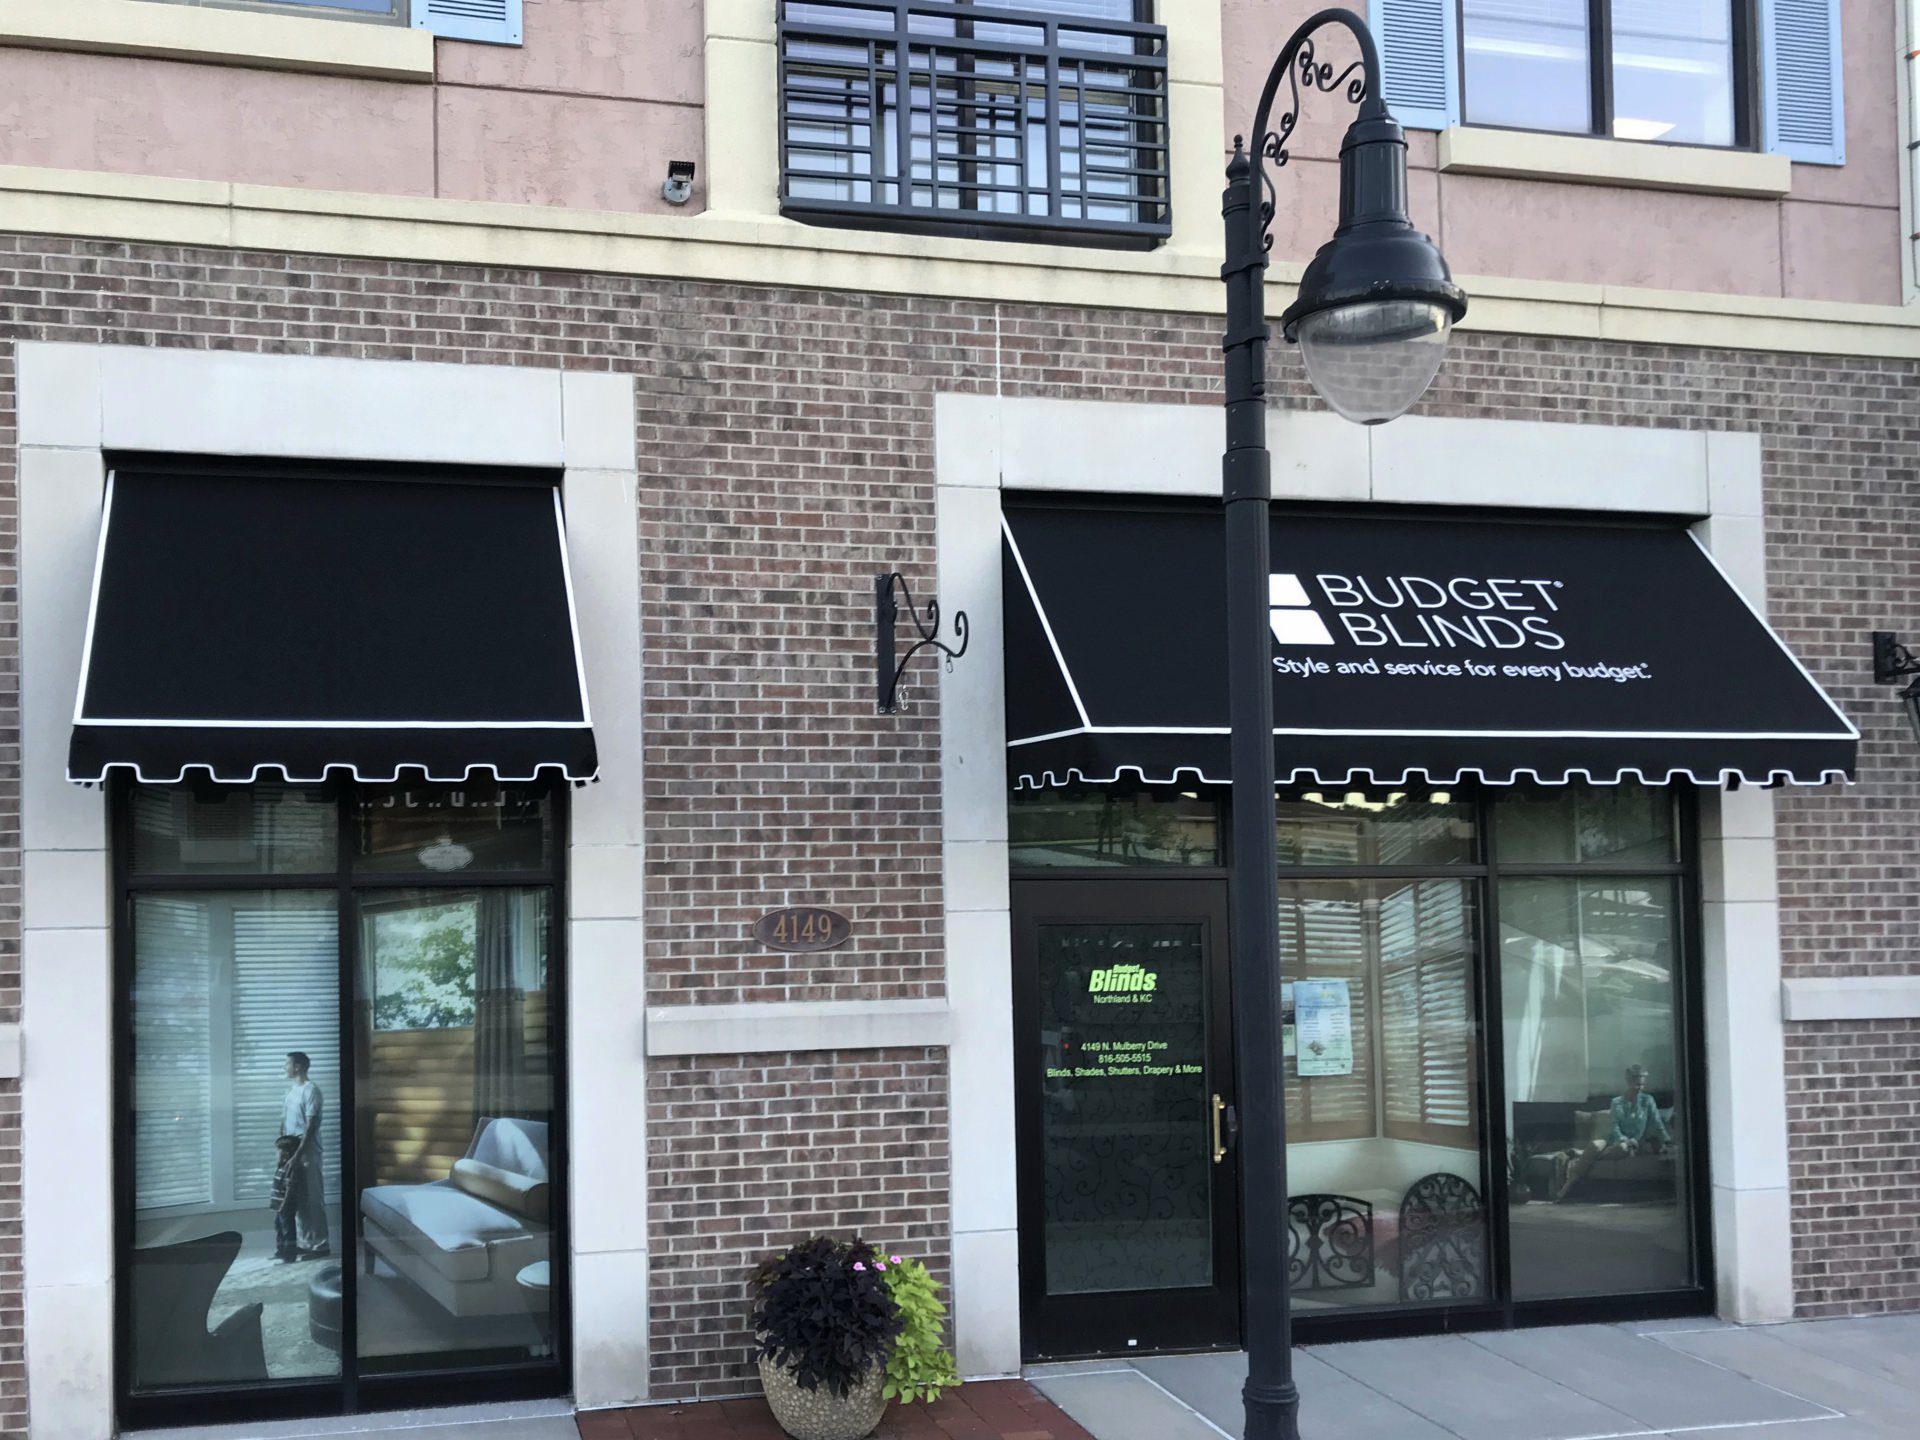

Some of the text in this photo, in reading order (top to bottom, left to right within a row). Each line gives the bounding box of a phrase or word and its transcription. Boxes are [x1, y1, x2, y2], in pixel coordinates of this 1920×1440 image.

[1338, 612, 1566, 650] BLINDS
[1272, 656, 1331, 678] Style
[1335, 658, 1380, 674] and
[1384, 660, 1462, 676] service
[1464, 659, 1497, 676] for
[1502, 665, 1561, 681] every
[773, 914, 832, 944] 4149
[1088, 968, 1158, 992] Blinds
[1093, 994, 1153, 1004] Northland & KC
[1081, 1041, 1168, 1052] 4149 N. Mulberry Drive
[1098, 1053, 1152, 1063] 816-505-5515
[1074, 1067, 1107, 1077] Shades,
[1107, 1066, 1142, 1076] Shutters,
[1143, 1065, 1174, 1076] Drapery
[1174, 1064, 1182, 1074] &
[1182, 1064, 1203, 1073] More
